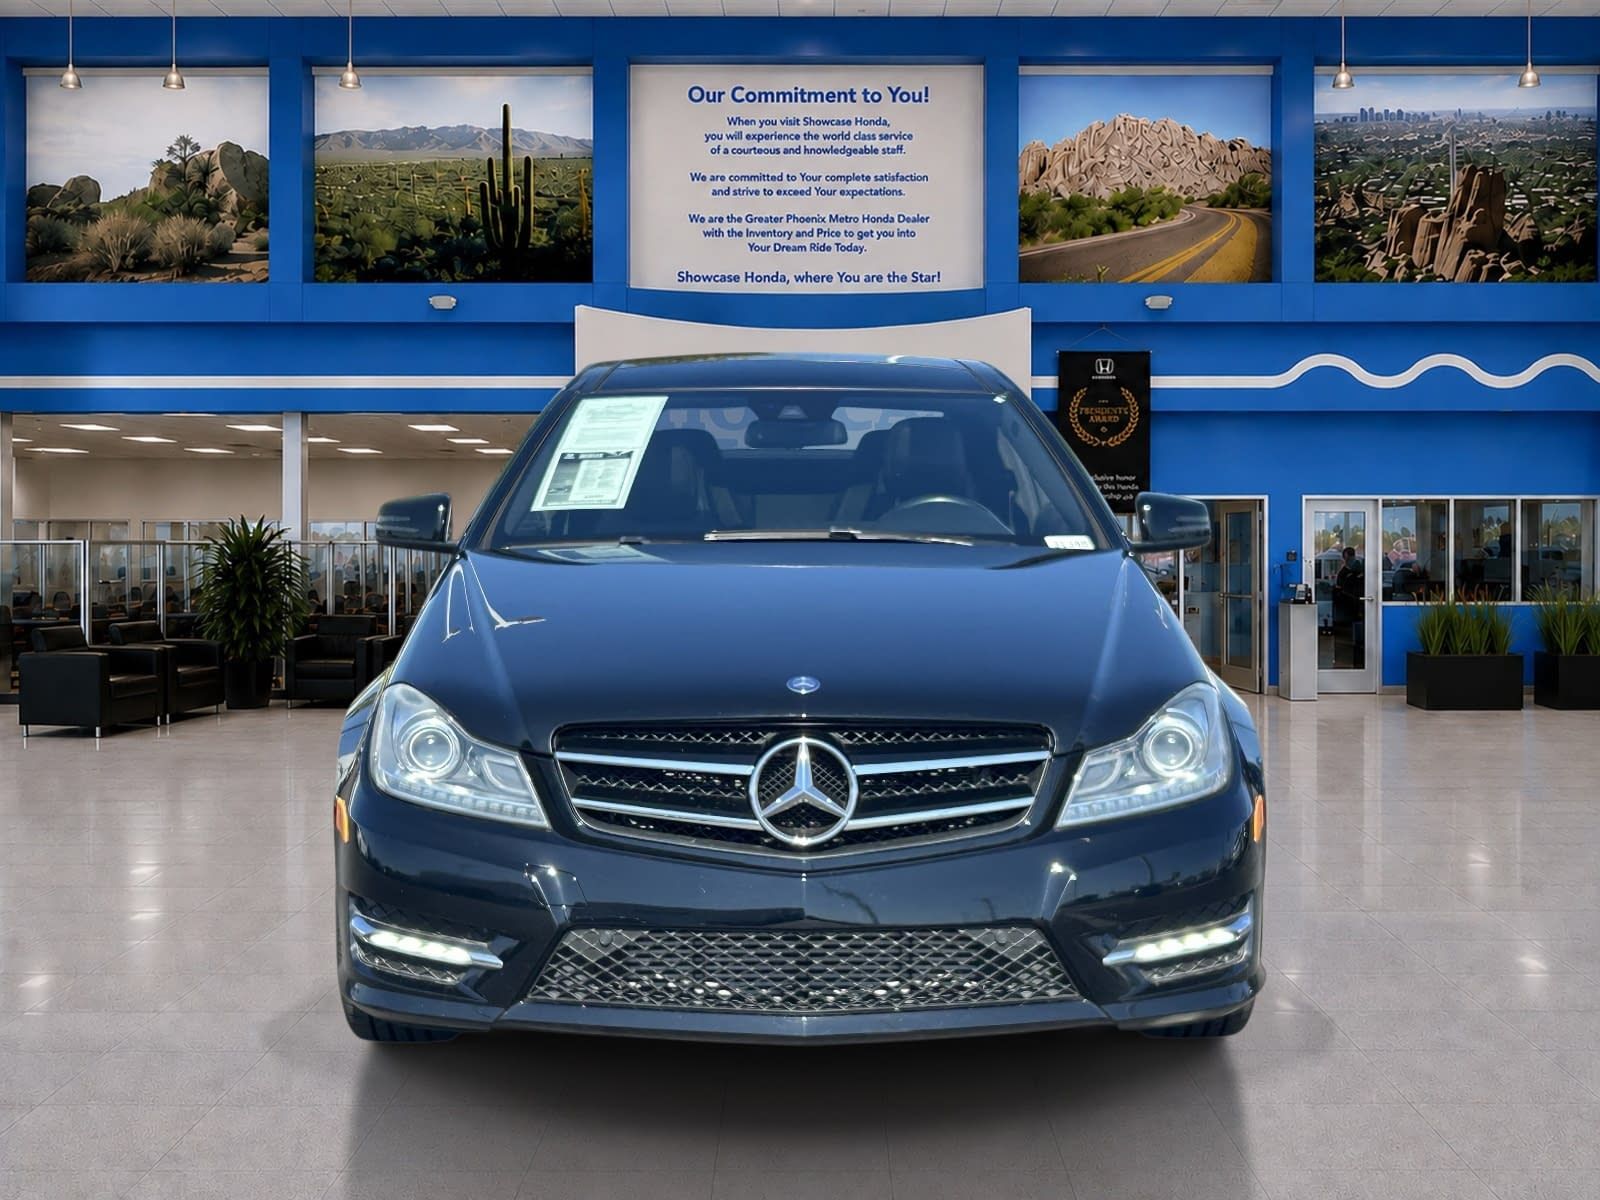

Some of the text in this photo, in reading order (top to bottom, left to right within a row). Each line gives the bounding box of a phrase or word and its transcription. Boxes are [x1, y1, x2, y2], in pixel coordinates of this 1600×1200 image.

[688, 85, 929, 103] Our Commitment to You!
[727, 116, 890, 128] When you visit Showcase Honda,
[704, 130, 913, 143] you will experience the world class service
[710, 144, 721, 155] of
[722, 147, 729, 155] a
[731, 146, 781, 155] courteous
[783, 145, 801, 155] and
[881, 144, 906, 155] staff.
[690, 172, 707, 182] We
[728, 172, 783, 182] committed
[786, 173, 797, 182] to
[799, 172, 822, 182] Your
[825, 172, 871, 184] complete
[873, 172, 928, 182] satisfaction
[711, 186, 905, 199] and strive to exceed Your expectations.
[688, 213, 930, 224] We are the Greater Phoenix Metro Honda Dealer
[702, 227, 916, 240] with the Inventory and Price to get you into
[747, 242, 867, 255] Your Dream Ride Today.
[677, 270, 941, 285] Showcase Honda, where You are the Star!
